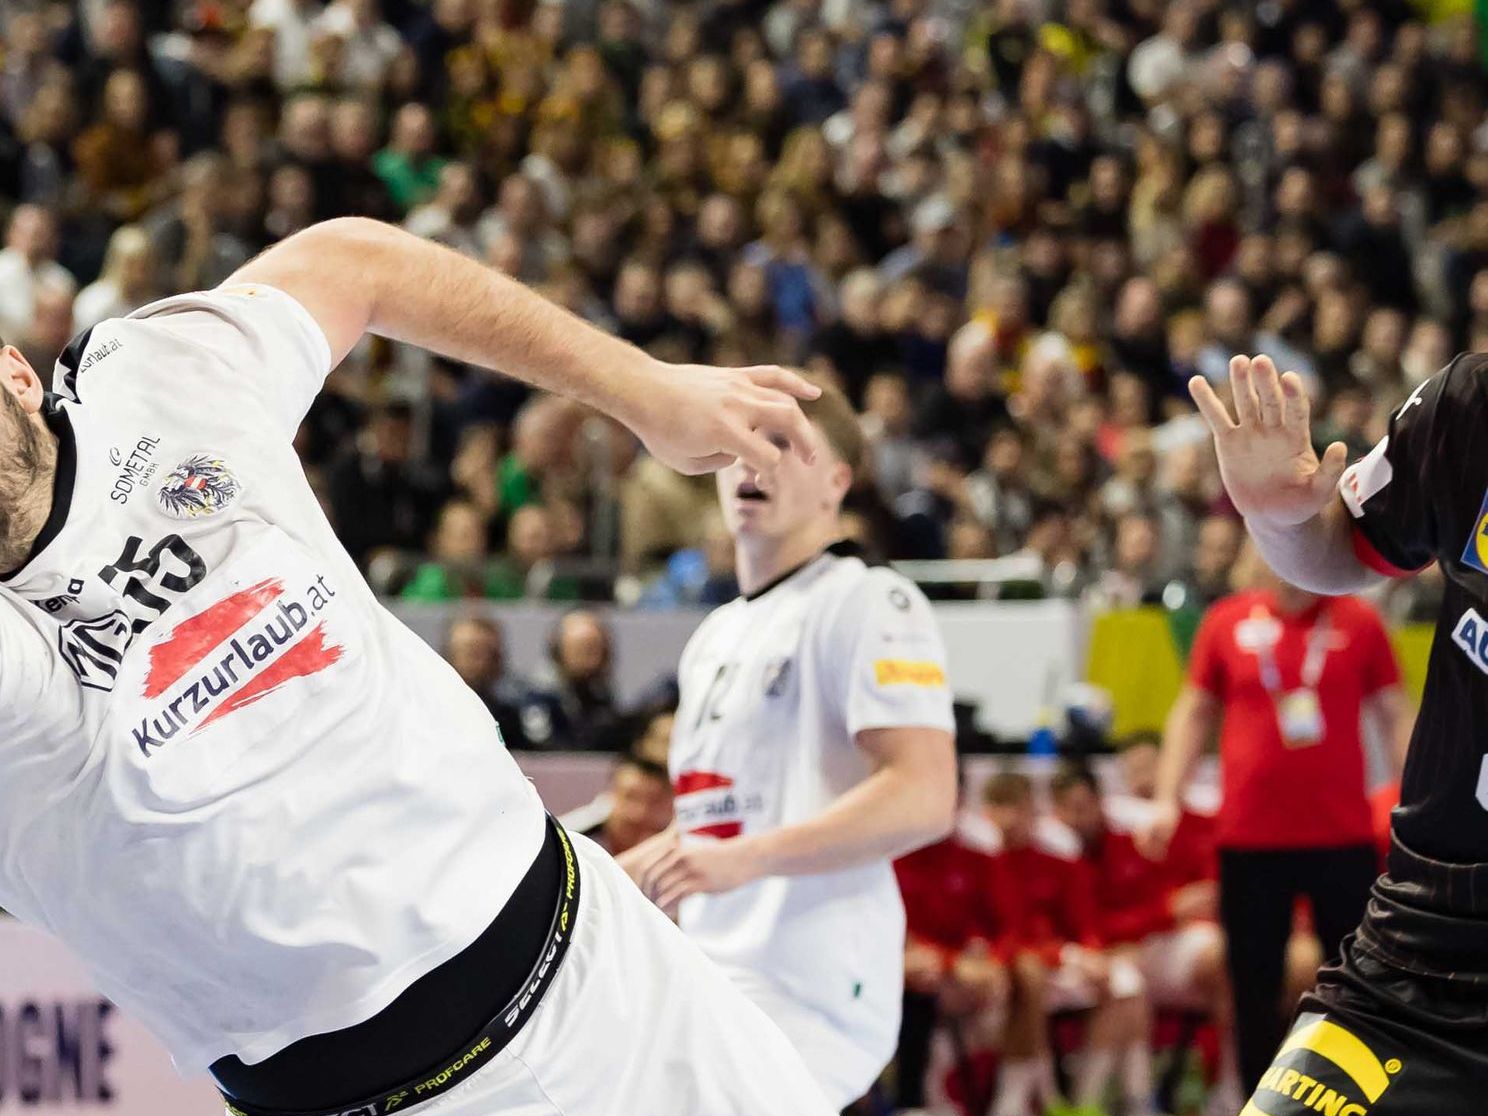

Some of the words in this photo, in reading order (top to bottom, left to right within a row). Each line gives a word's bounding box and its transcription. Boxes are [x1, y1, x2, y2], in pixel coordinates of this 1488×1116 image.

[110, 436, 161, 505] SOMETAL
[132, 574, 335, 758] Kurzurlaub.at
[414, 1036, 491, 1094] PROFCARE
